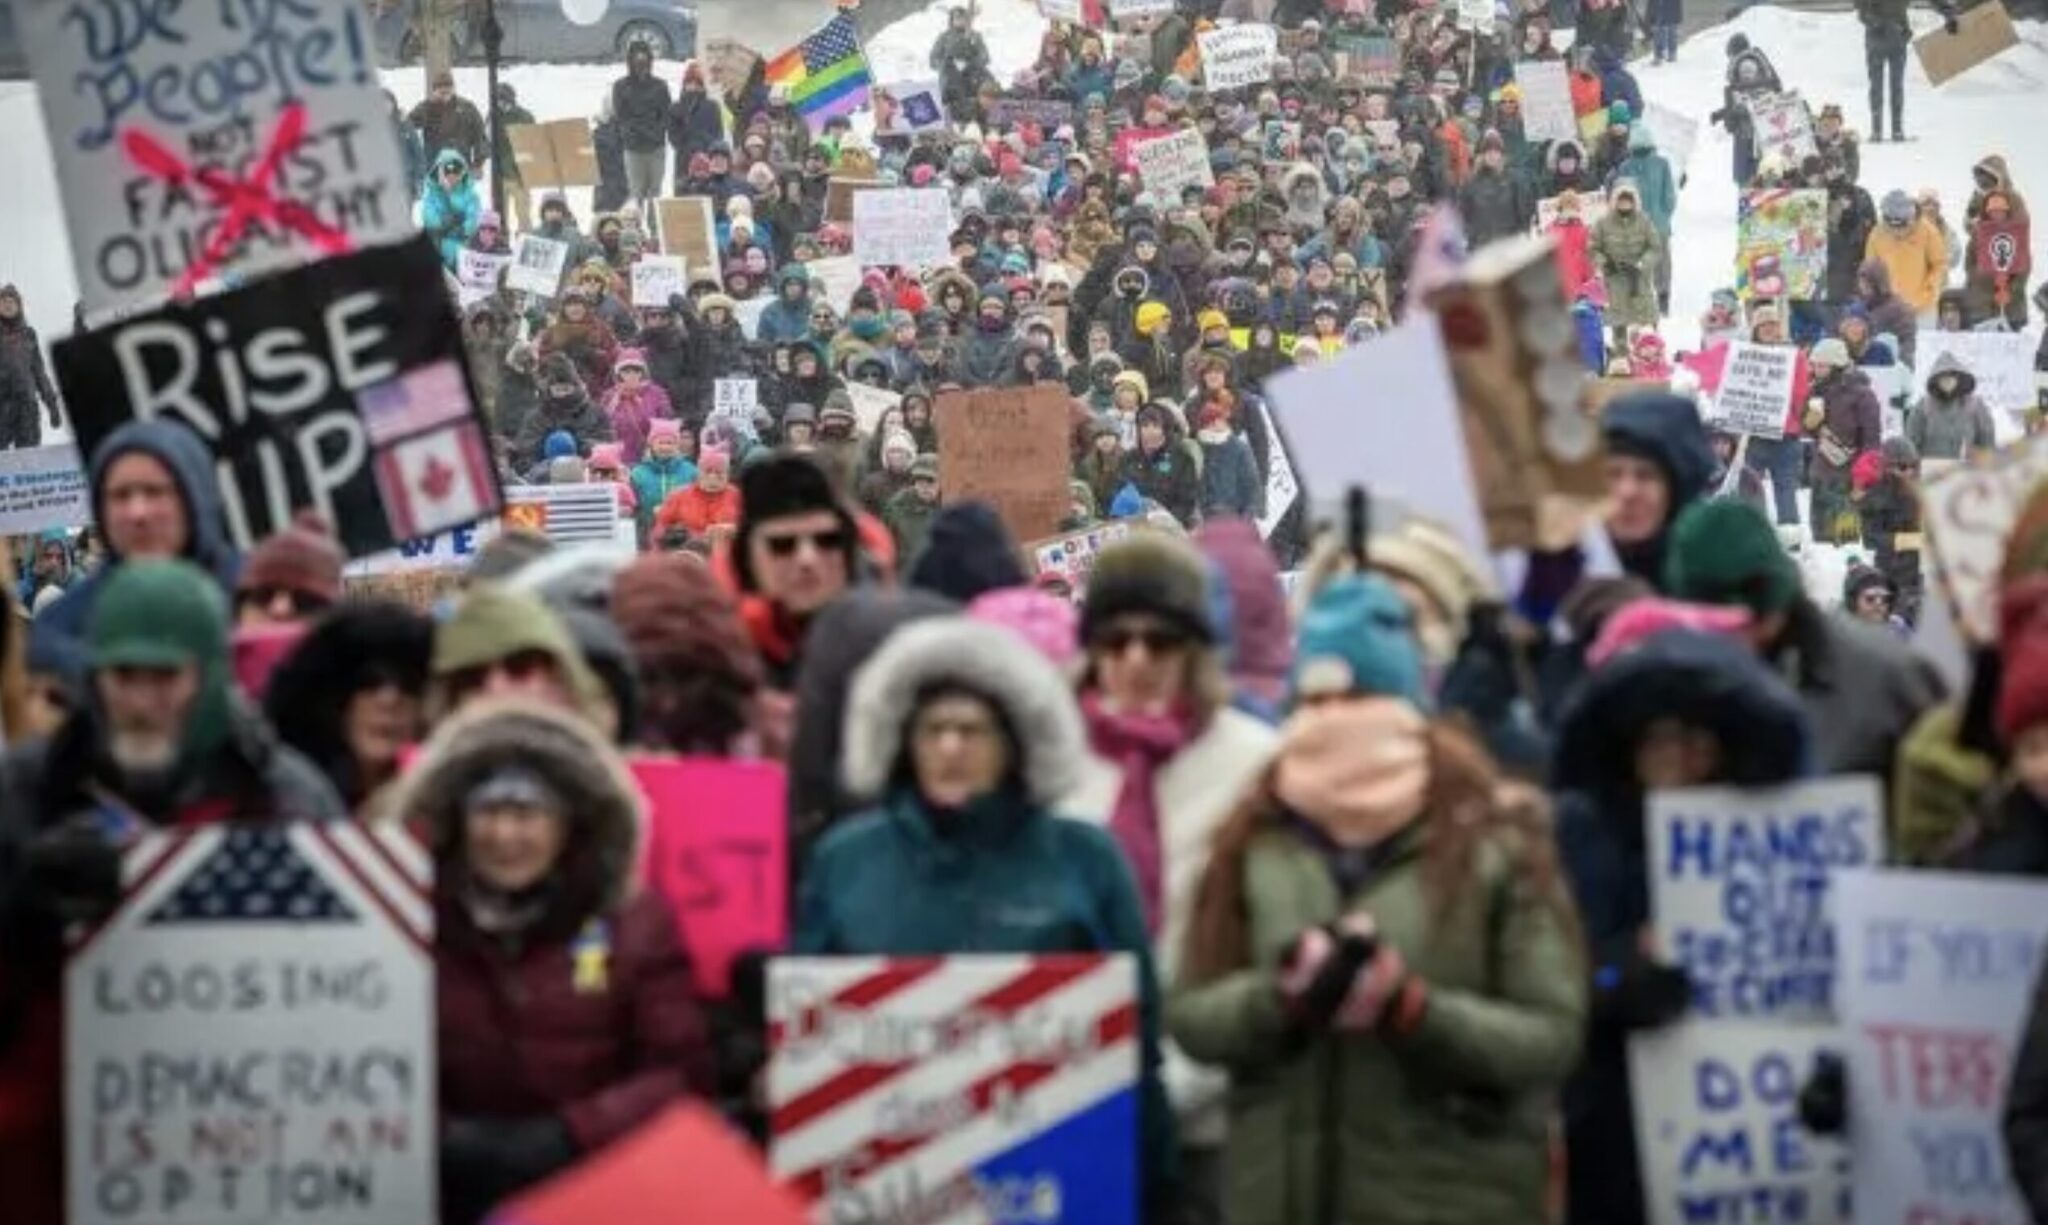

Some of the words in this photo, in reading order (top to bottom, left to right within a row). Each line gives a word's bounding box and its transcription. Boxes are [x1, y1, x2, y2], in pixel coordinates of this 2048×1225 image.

[1668, 807, 1867, 877] HANDS
[93, 957, 390, 1014] LOOSING
[92, 1114, 156, 1169] IS
[95, 1159, 375, 1219] OPTION
